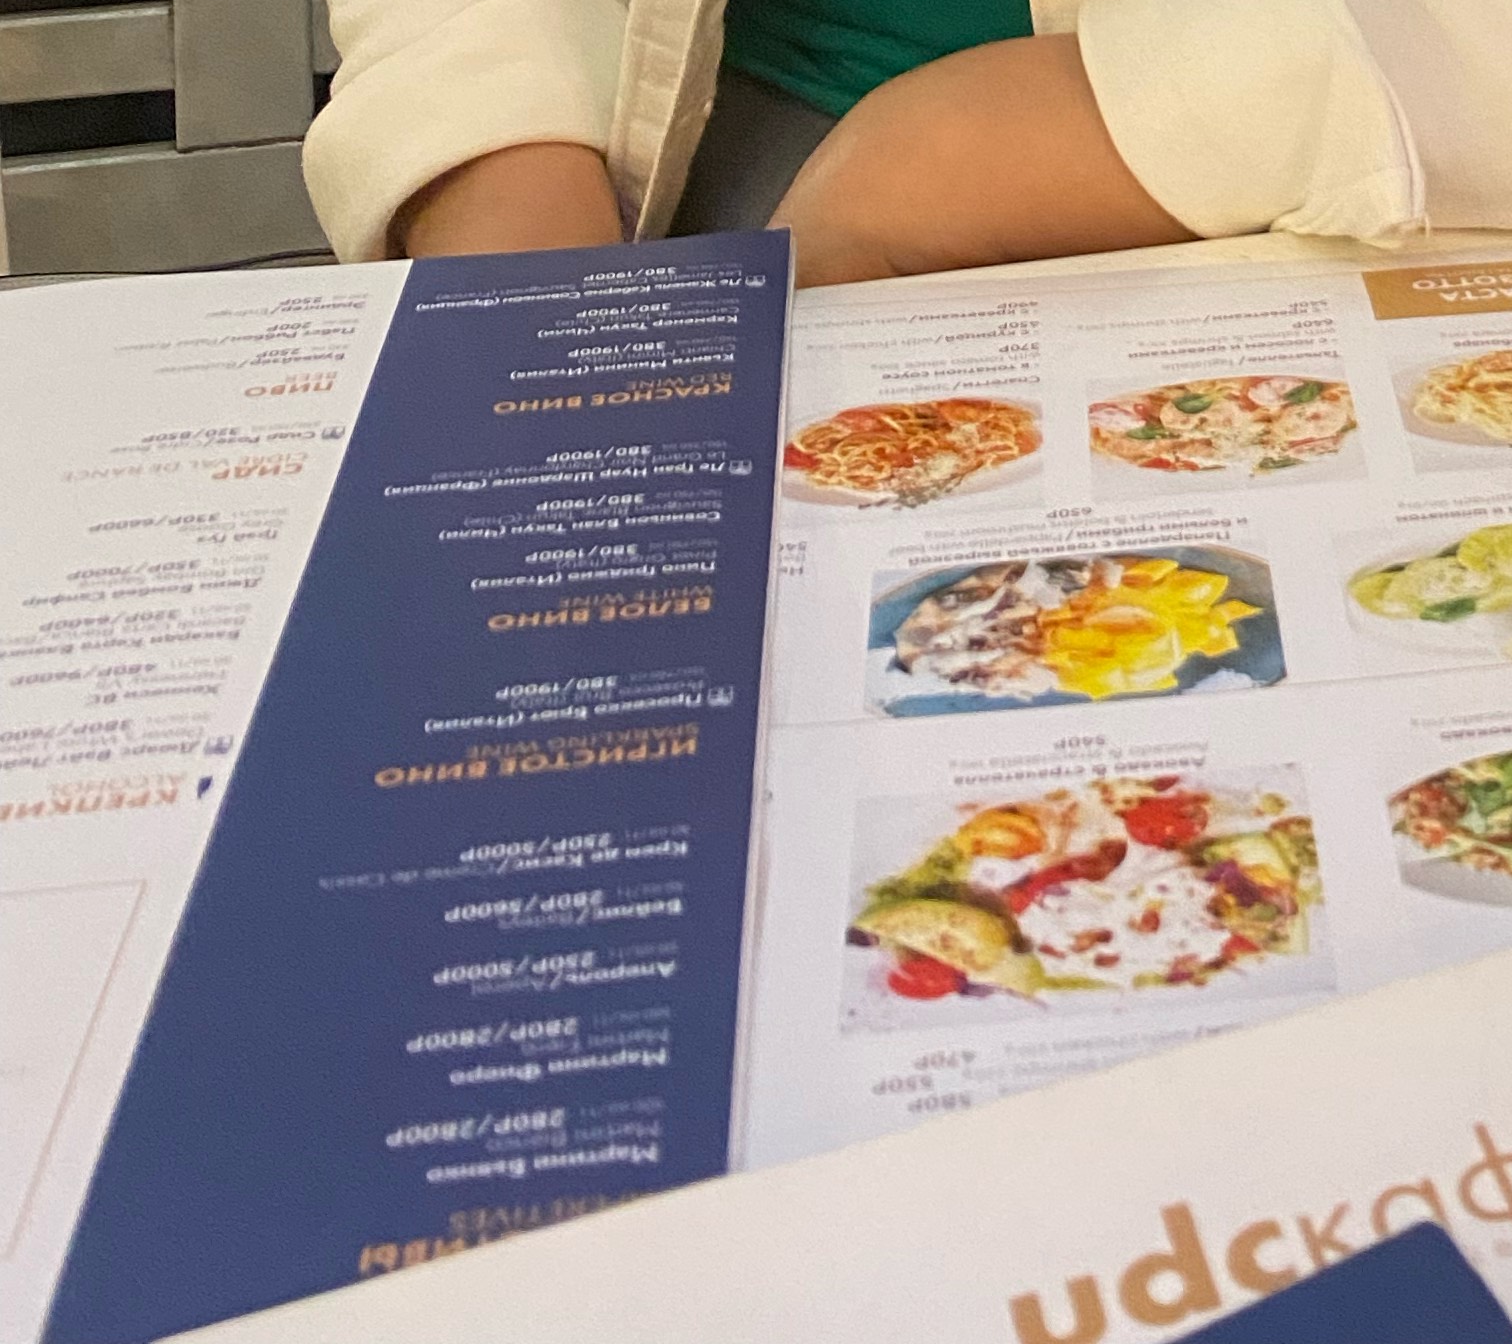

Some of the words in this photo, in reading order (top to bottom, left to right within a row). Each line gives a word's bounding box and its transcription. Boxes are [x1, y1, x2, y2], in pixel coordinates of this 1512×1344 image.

[599, 319, 648, 334] Такун
[671, 352, 734, 365] Кьянти
[625, 377, 684, 391] WINE
[689, 372, 733, 385] RED
[243, 379, 334, 398] ПИВО
[589, 381, 732, 407] КРАСНОЕ
[492, 395, 583, 415] ВИНО
[265, 430, 317, 442] Сидр
[210, 462, 304, 482] СИДР
[600, 464, 648, 481] Нуар
[652, 461, 694, 477] Гран
[698, 461, 725, 474] Ле
[510, 519, 566, 537] Такун
[570, 516, 620, 532] Блан
[624, 510, 722, 527] Совиньон
[437, 524, 506, 542] (Чили)
[566, 563, 656, 583] Гриджио
[661, 559, 716, 575] Пино
[599, 595, 712, 622] БЕЛОЕ
[486, 606, 590, 633] ВИНО
[528, 705, 587, 724] Брют
[465, 740, 539, 760] WINE
[498, 736, 697, 776] ИГРИСТОЕ
[372, 759, 487, 789] ВИНО
[547, 1046, 669, 1073] Мартини
[448, 1064, 542, 1086] Фиеро
[533, 1142, 660, 1170] Мартини
[425, 1157, 525, 1184] Бьянко
